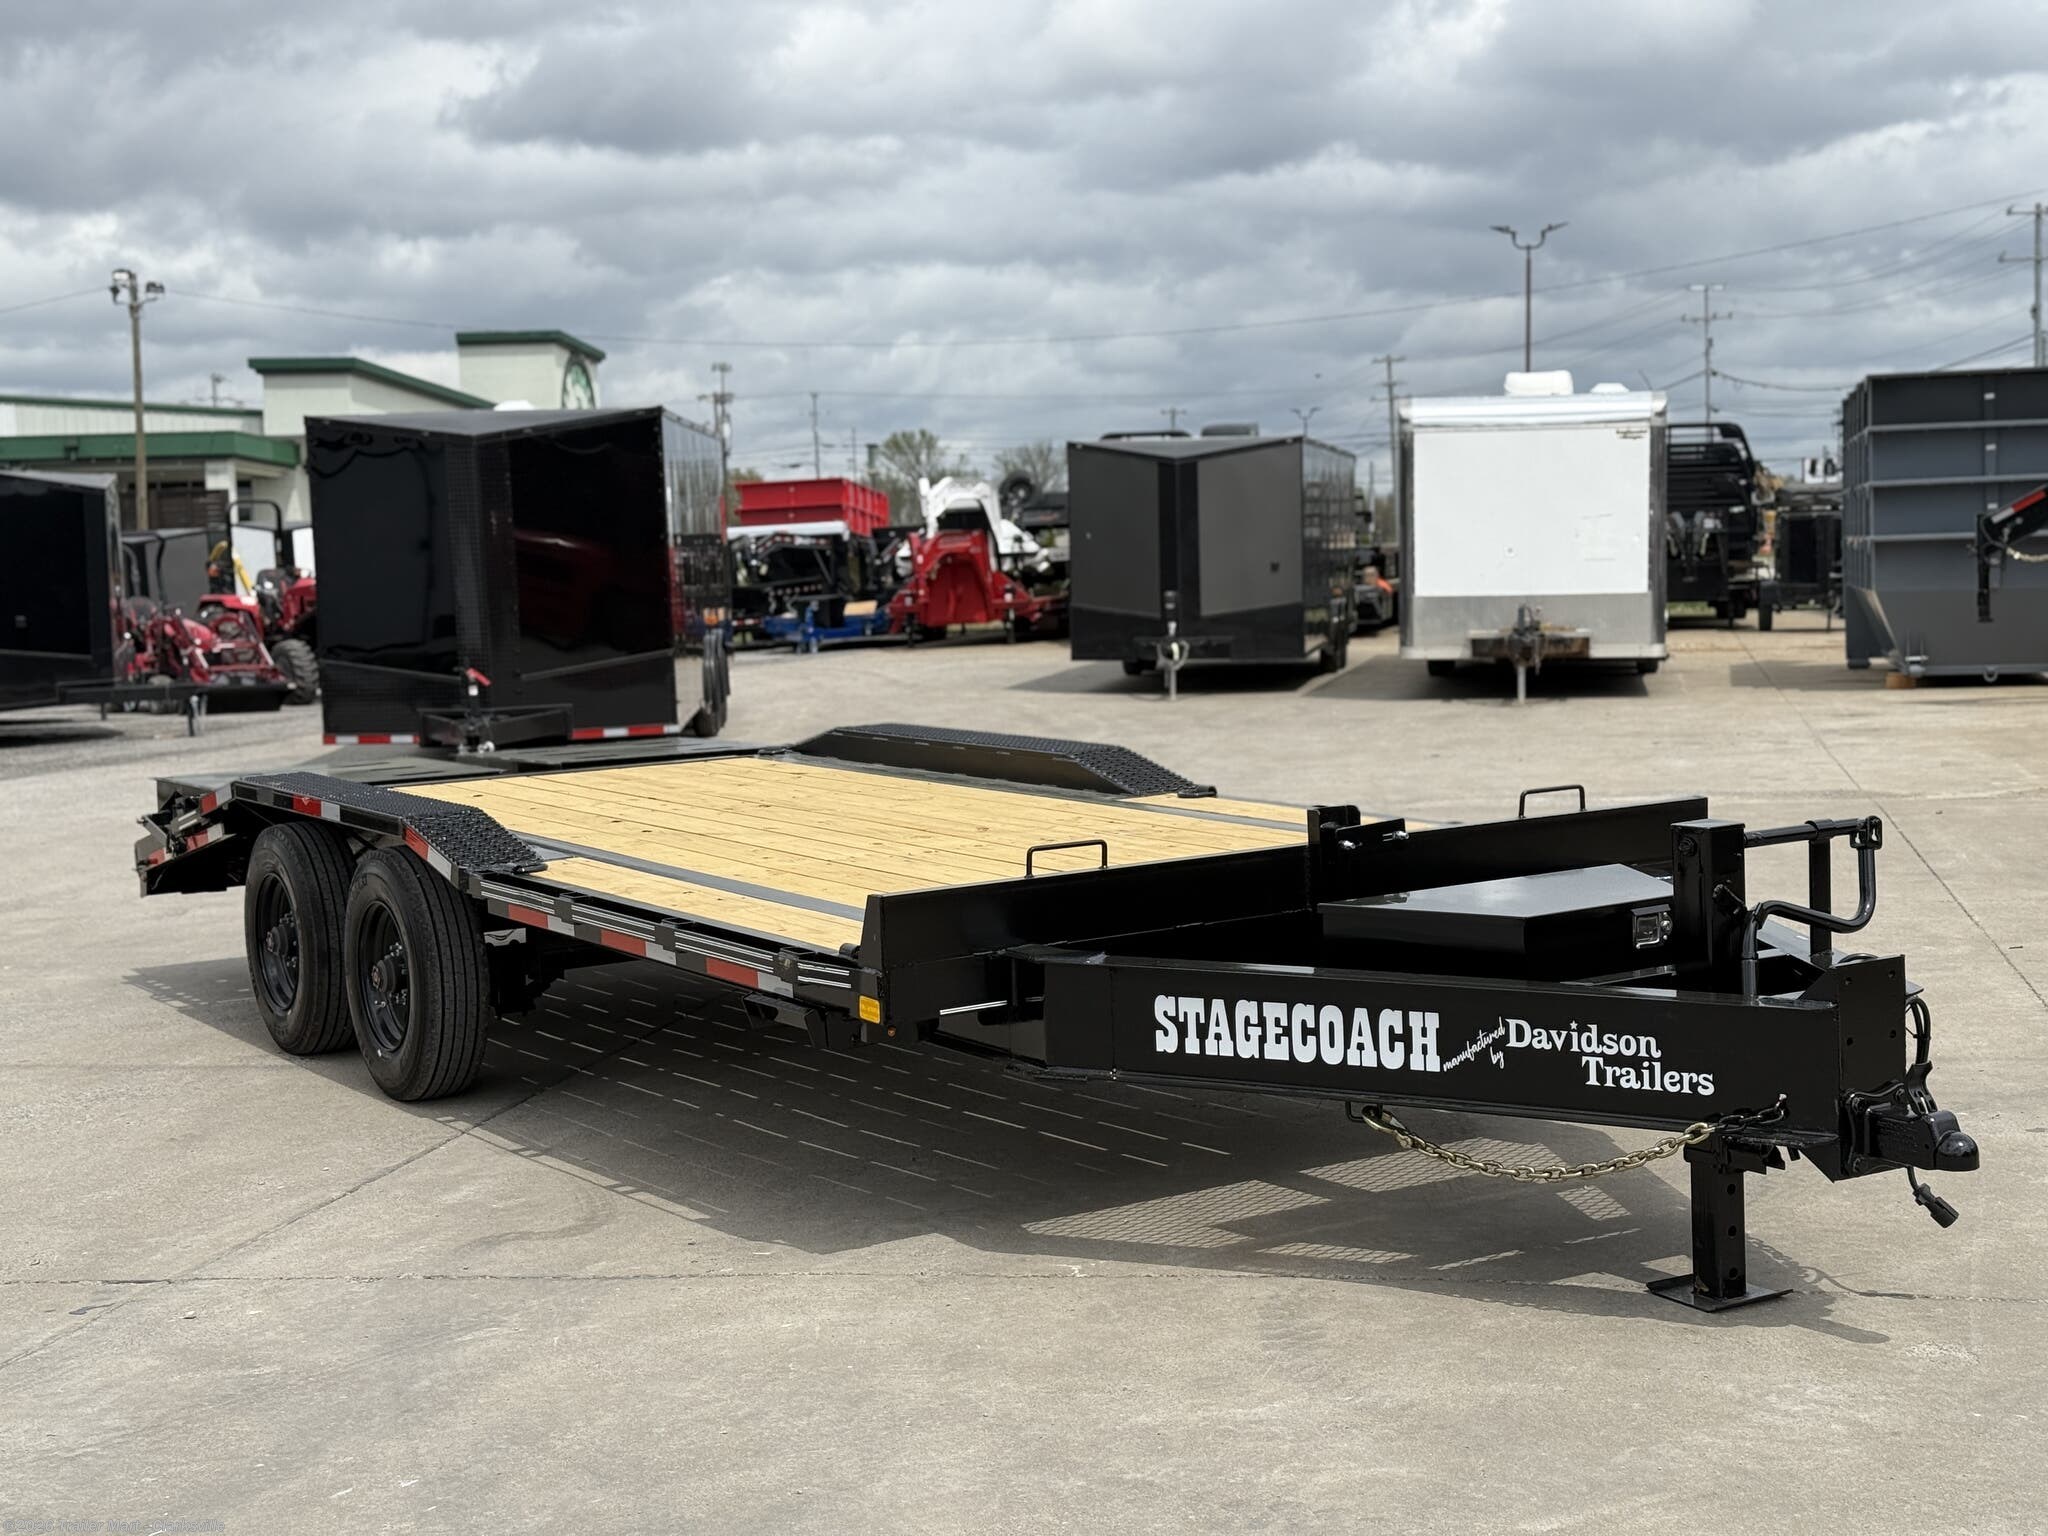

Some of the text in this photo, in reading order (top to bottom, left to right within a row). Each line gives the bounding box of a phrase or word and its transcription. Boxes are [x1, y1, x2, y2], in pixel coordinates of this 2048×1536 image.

[1153, 994, 1441, 1073] STAGECOACH
[1442, 1015, 1506, 1073] manufactured
[1504, 1018, 1662, 1059] Davidson
[1489, 1046, 1505, 1070] by
[1581, 1055, 1715, 1097] Trailers
